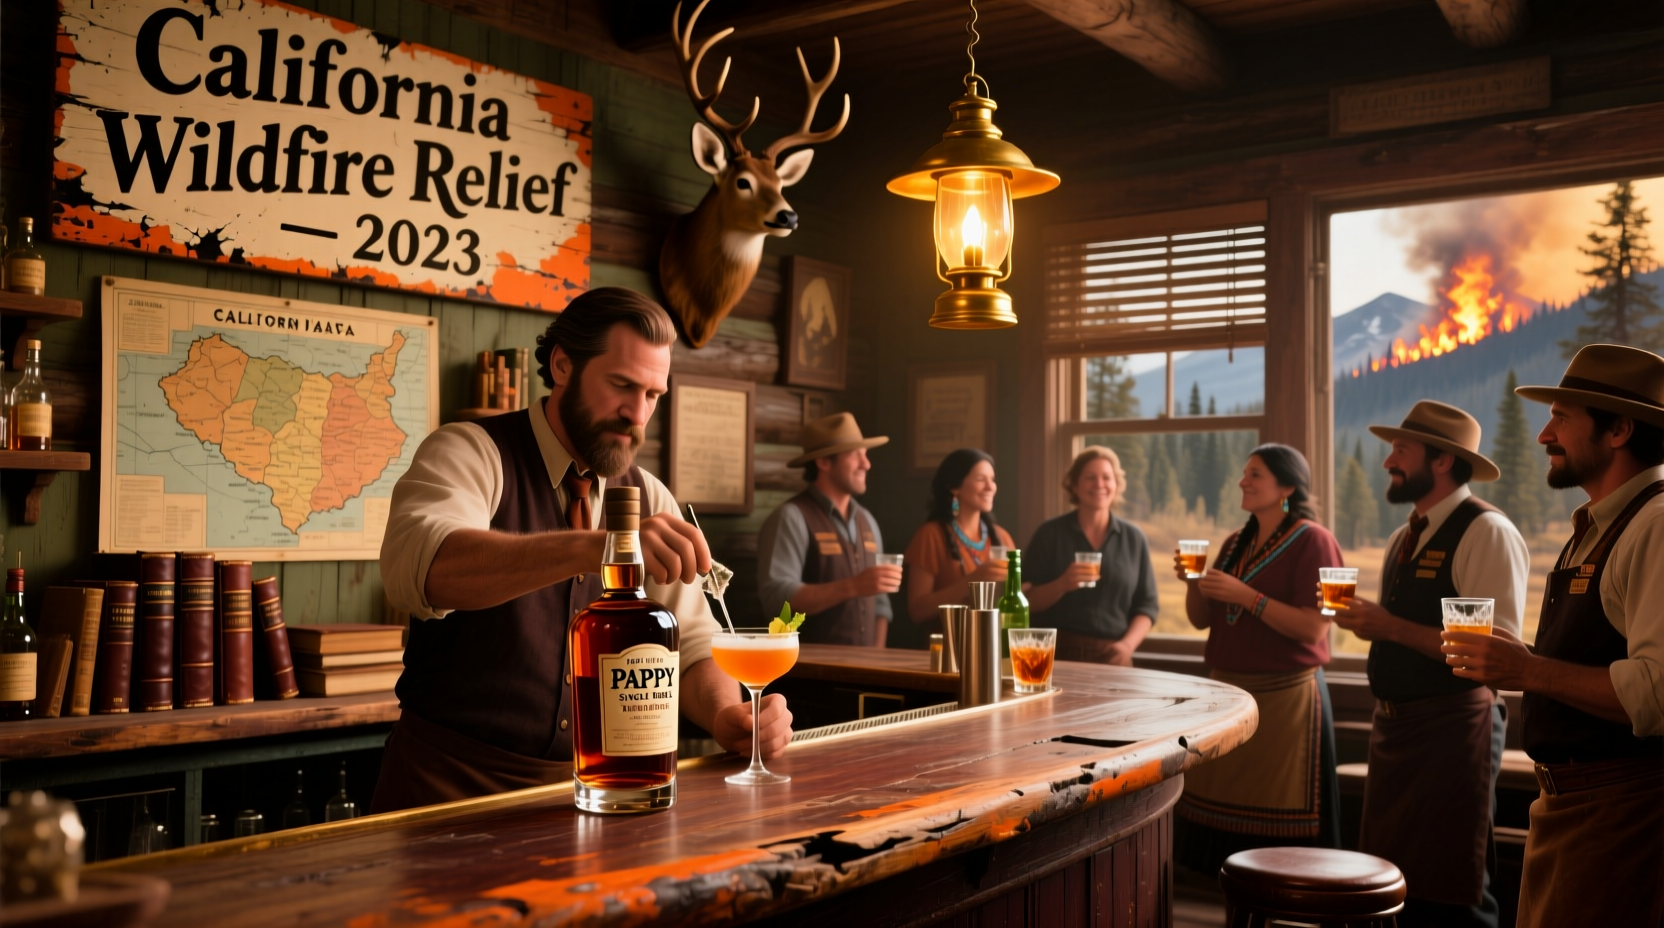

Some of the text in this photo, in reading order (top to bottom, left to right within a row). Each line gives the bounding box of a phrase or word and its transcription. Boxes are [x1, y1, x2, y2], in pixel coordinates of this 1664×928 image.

[136, 7, 511, 141] California
[96, 109, 578, 219] Wildfire Relief
[353, 213, 481, 276] 2023
[610, 667, 675, 689] PAPPY
